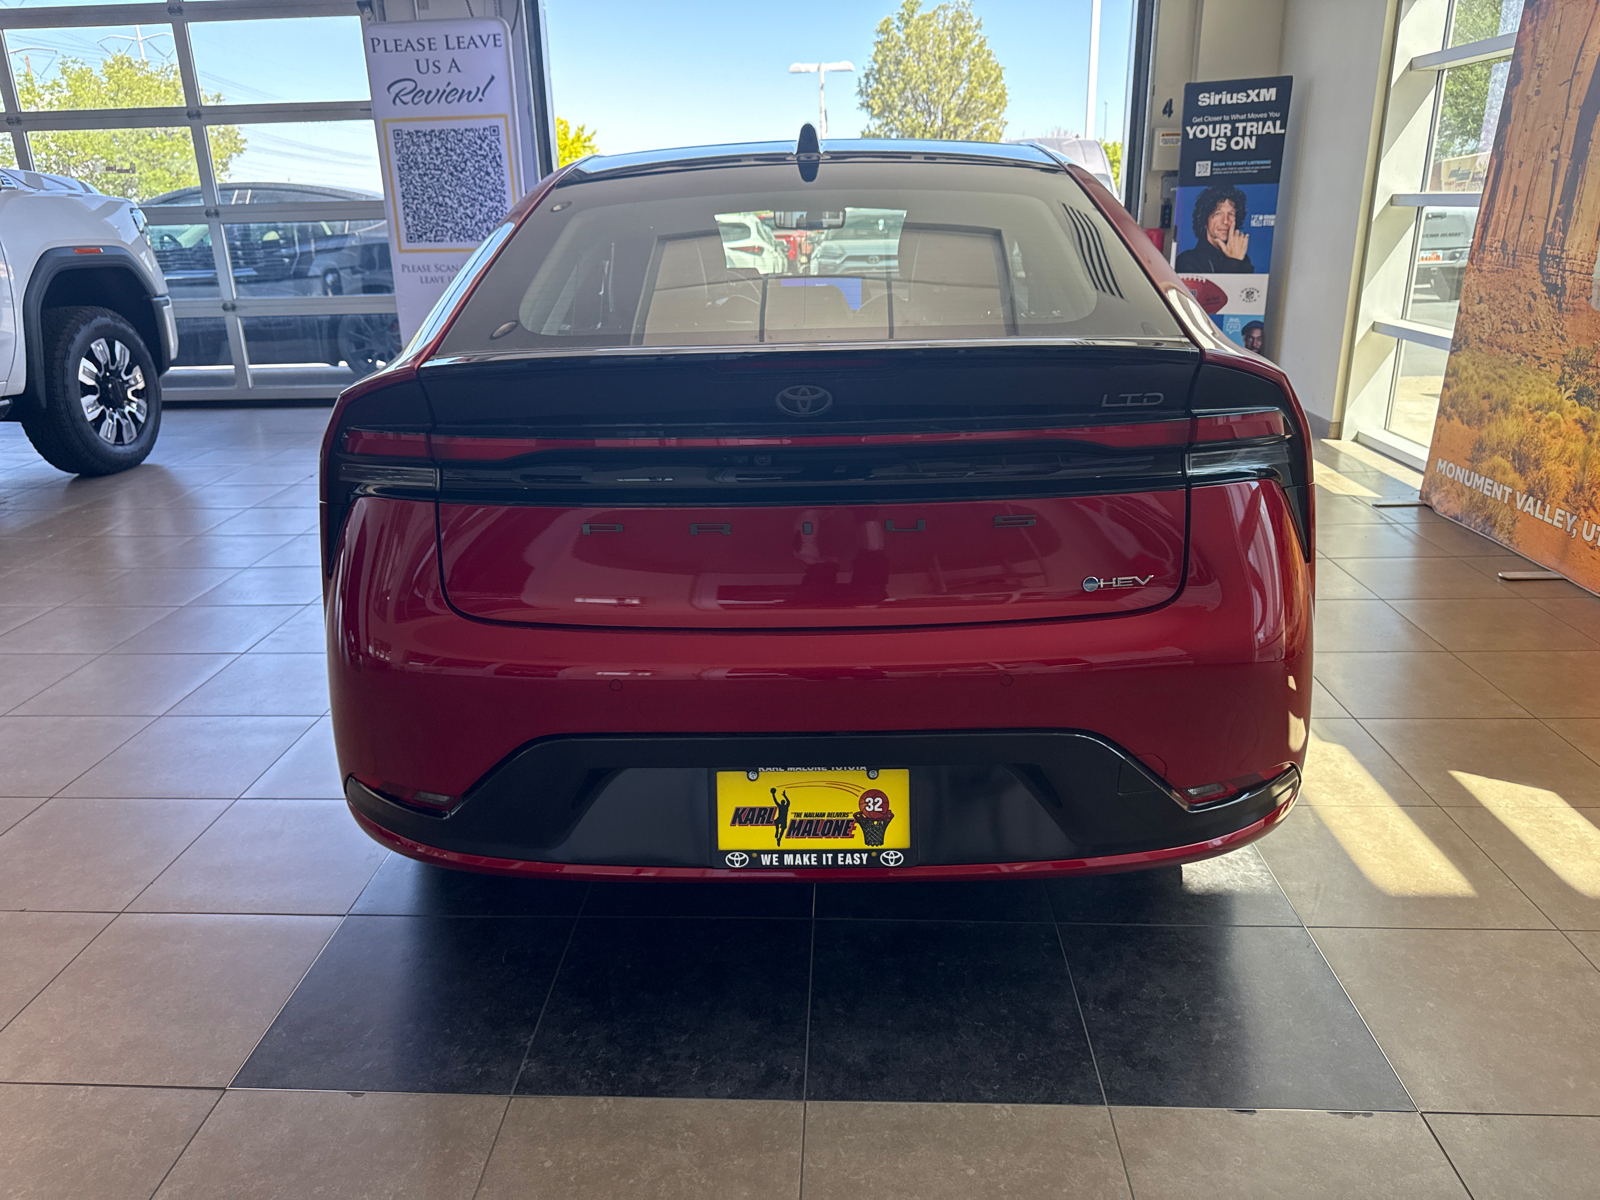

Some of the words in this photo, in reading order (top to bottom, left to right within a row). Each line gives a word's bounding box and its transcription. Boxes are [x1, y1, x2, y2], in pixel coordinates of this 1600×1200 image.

[370, 37, 437, 53] PLEASE
[443, 33, 503, 51] LEAVE
[415, 58, 441, 75] US
[447, 57, 462, 73] A
[387, 74, 495, 106] Review!
[1198, 87, 1277, 107] SiriusXM
[1162, 98, 1174, 119] 4
[1186, 123, 1232, 139] YOUR
[1235, 120, 1285, 136] TRIAL
[1210, 137, 1227, 152] IS
[1230, 136, 1257, 151] ON
[401, 263, 431, 273] PLEASE
[419, 275, 446, 285] LEAVE
[1101, 392, 1165, 408] LTD
[1436, 458, 1513, 504] MONUMENT
[1516, 491, 1578, 539] VALLEY,
[582, 514, 1037, 536] PRIUS
[1099, 575, 1155, 589] HEV
[865, 797, 883, 812] 32
[730, 806, 777, 826] KARL
[785, 819, 857, 839] MALONE
[761, 854, 780, 866] WE
[784, 853, 818, 866] MAKE
[822, 853, 834, 865] IT
[838, 852, 868, 865] EASY
